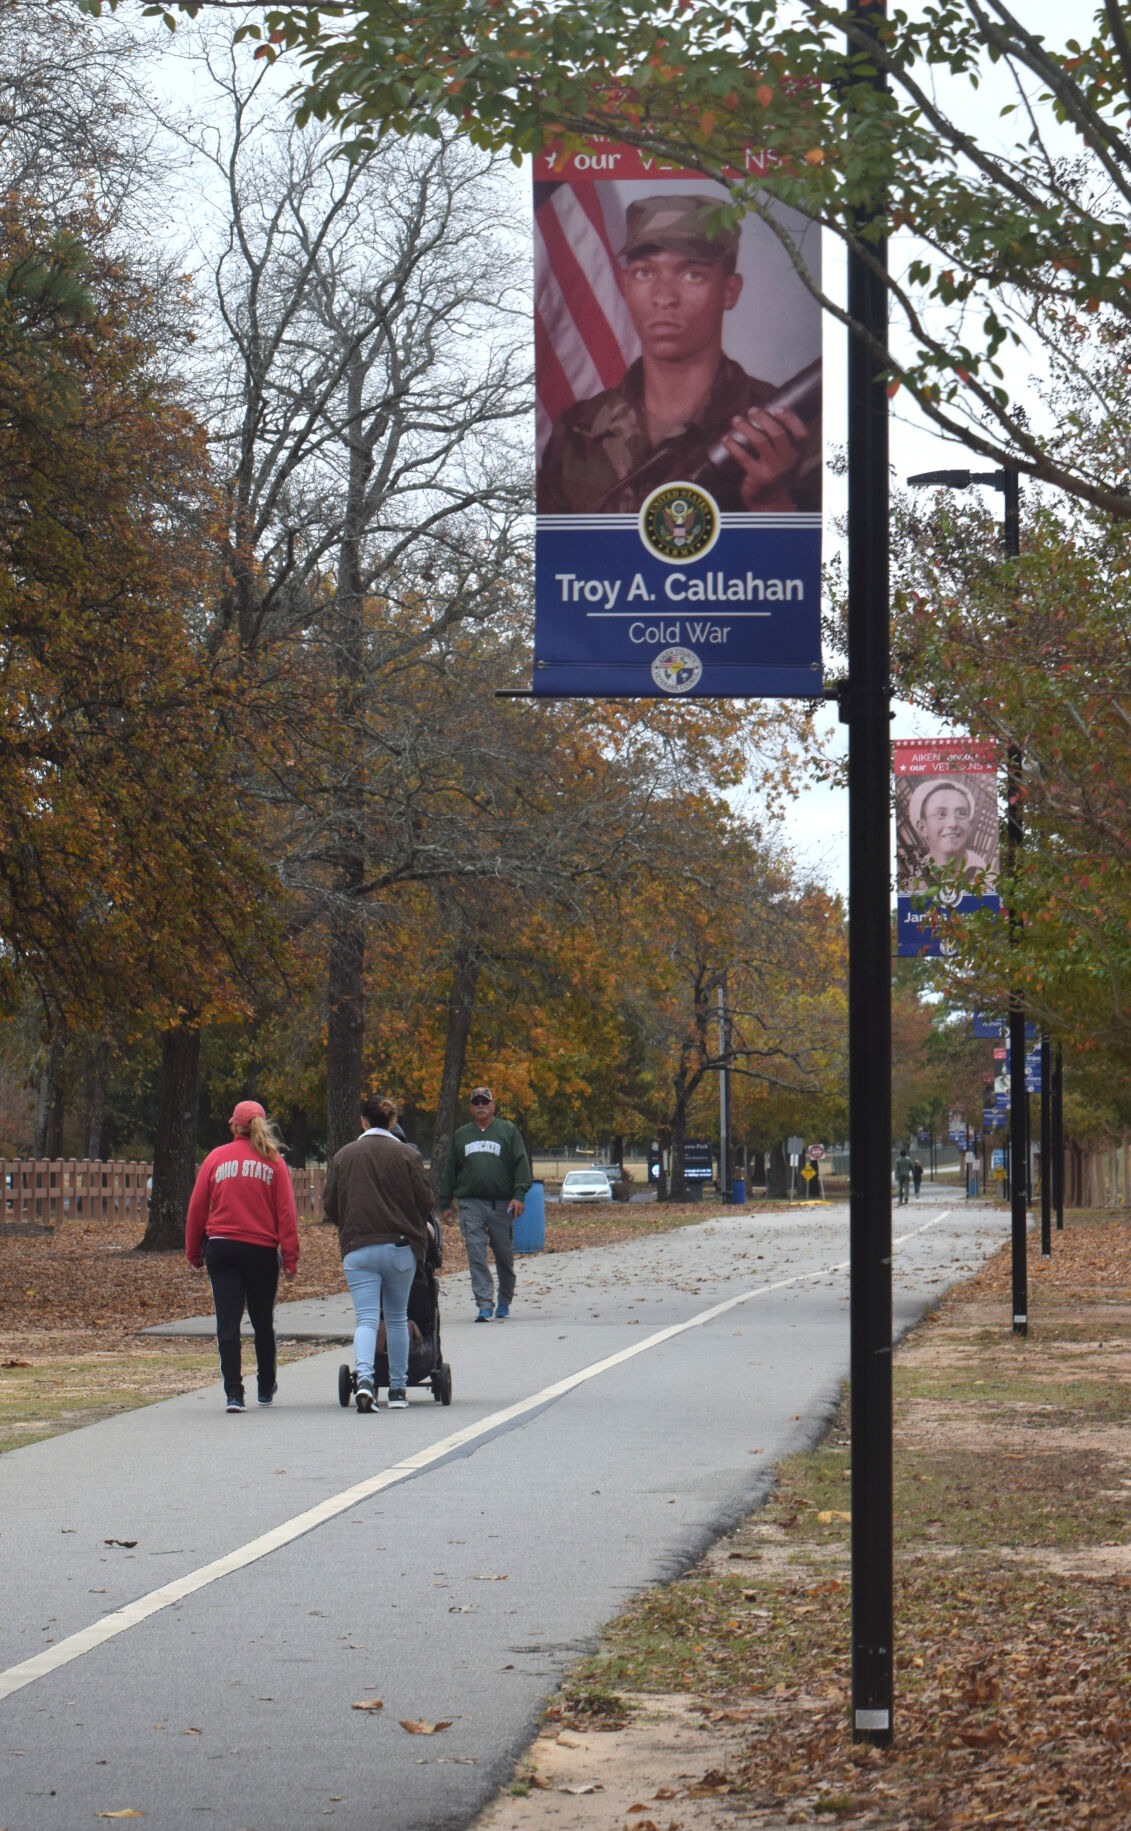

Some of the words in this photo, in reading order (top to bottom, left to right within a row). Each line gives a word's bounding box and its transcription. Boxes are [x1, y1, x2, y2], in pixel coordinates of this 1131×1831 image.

[574, 154, 621, 169] our
[555, 574, 621, 609] Troy
[627, 574, 655, 601] A.
[664, 572, 803, 601] Callahan
[629, 622, 680, 643] Cold
[686, 622, 731, 643] War
[912, 753, 940, 762] AIKEN
[910, 764, 926, 772] our
[215, 1160, 239, 1184] OHIO
[241, 1160, 274, 1186] STATE
